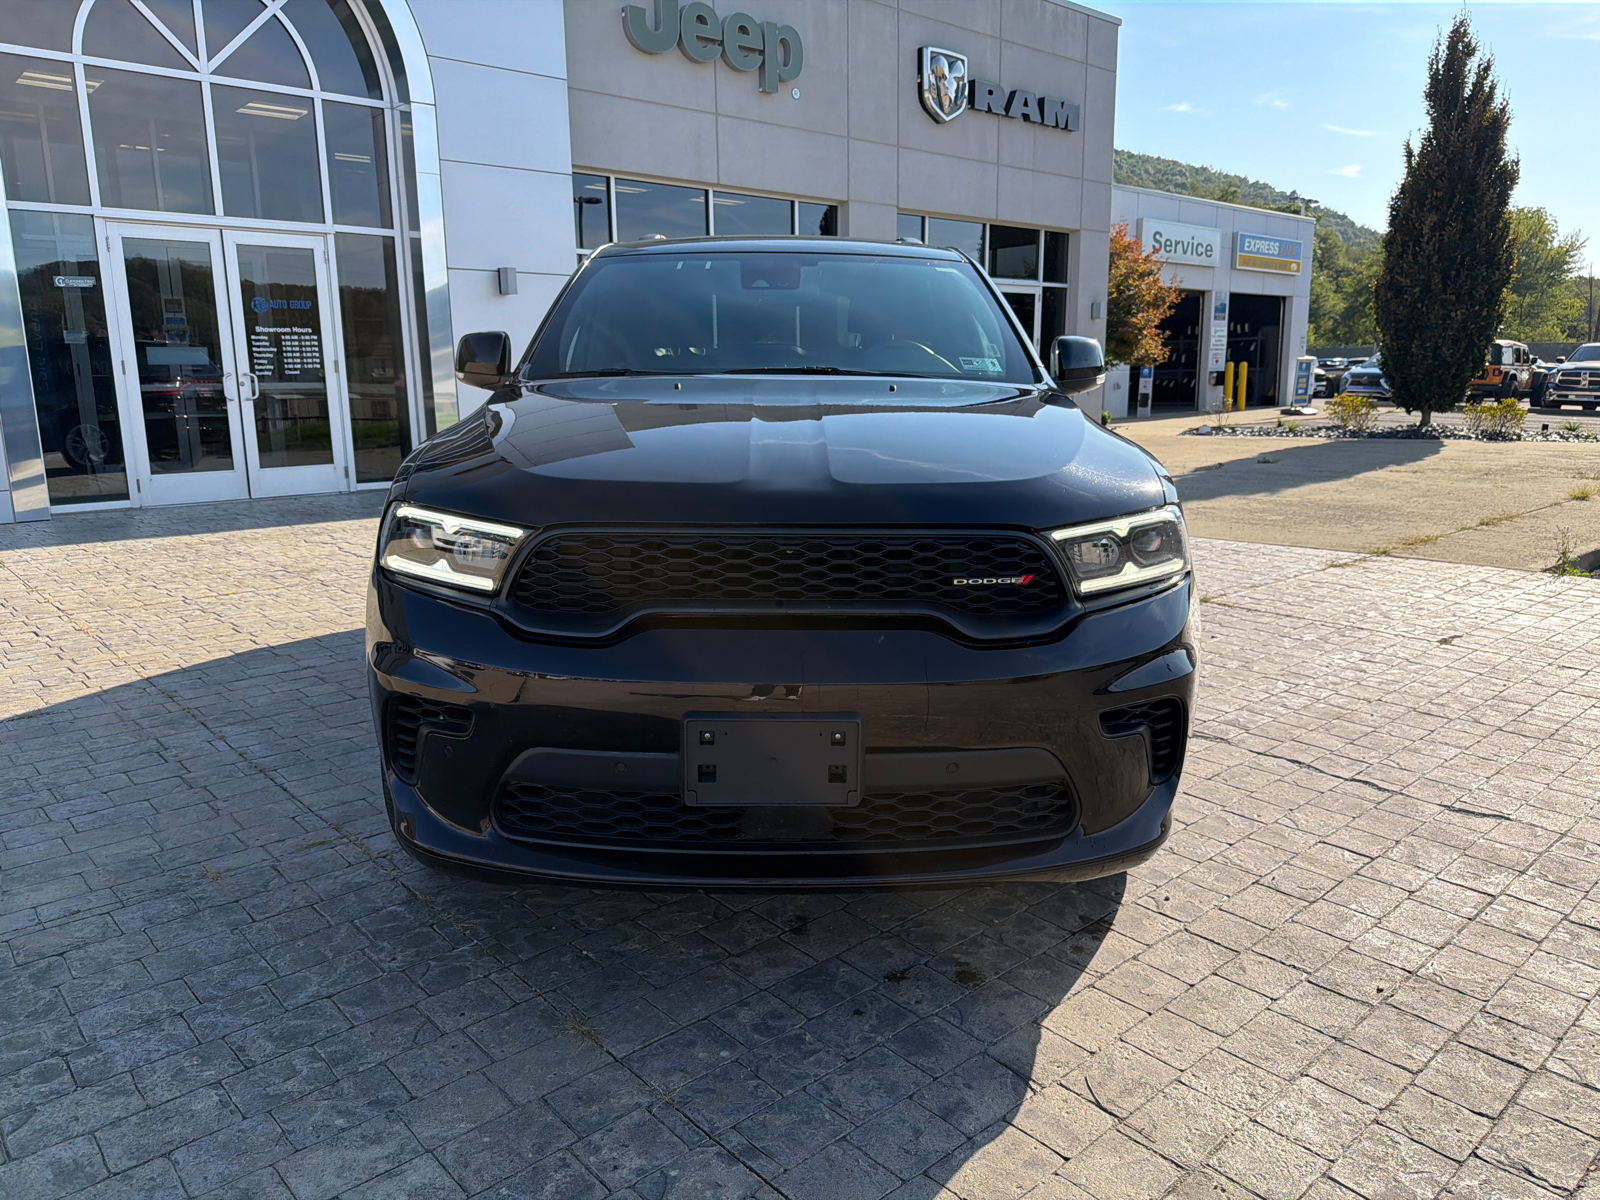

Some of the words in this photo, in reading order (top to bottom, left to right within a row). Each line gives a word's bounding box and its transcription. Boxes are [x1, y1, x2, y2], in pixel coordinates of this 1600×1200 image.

[621, 0, 803, 93] Jeep
[967, 79, 1080, 132] RAM
[1152, 231, 1213, 258] Service
[1244, 238, 1279, 255] EXPRESS
[270, 299, 288, 309] AUTO
[289, 300, 312, 310] GROUP
[953, 577, 1024, 585] DODGE
